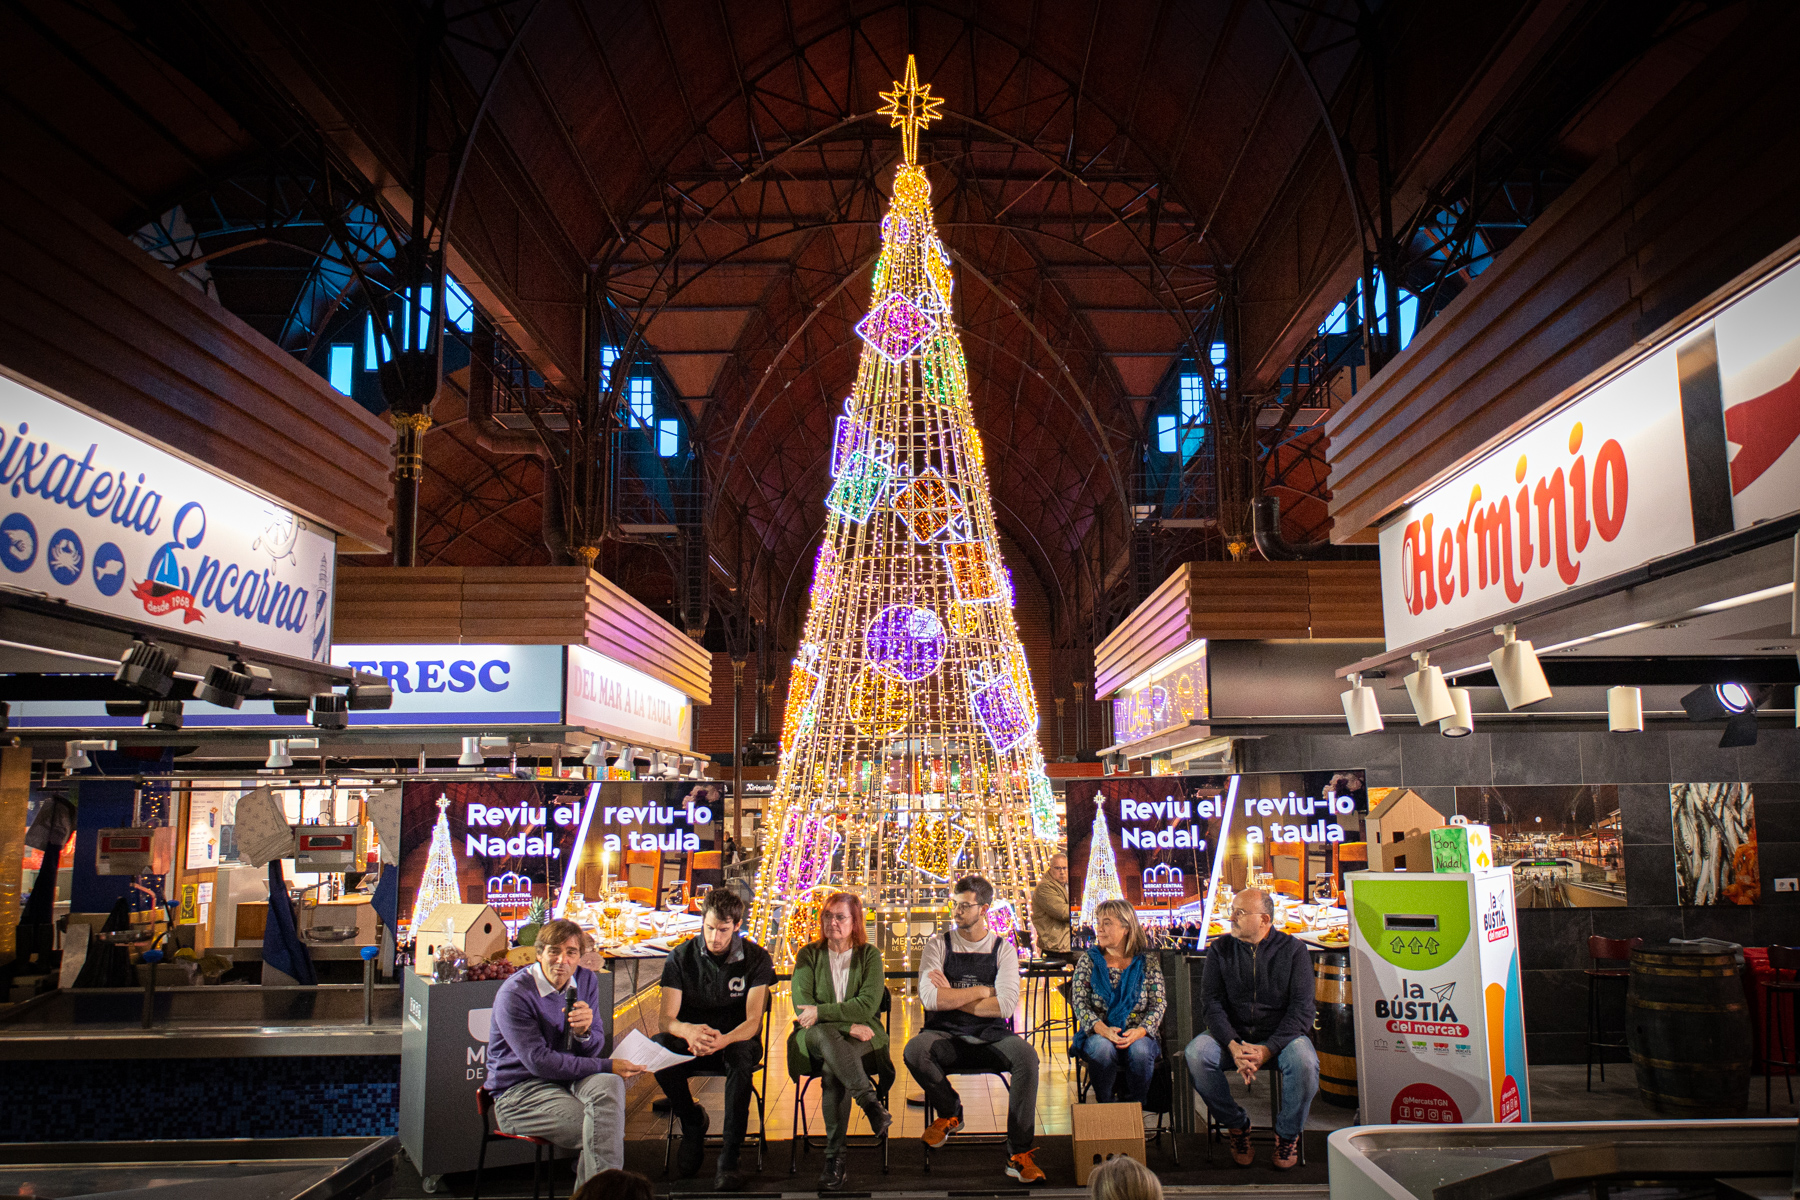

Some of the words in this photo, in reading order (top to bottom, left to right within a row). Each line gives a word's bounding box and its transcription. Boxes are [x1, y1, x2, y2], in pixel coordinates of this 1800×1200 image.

[0, 421, 163, 536] ixateria
[1403, 421, 1629, 617] Herminio
[147, 501, 309, 634] Encarna
[147, 600, 170, 612] desde
[171, 595, 190, 608] 1968
[573, 665, 597, 702] DEL
[599, 675, 622, 711] MAR
[624, 687, 632, 713] A
[633, 689, 645, 718] LA
[647, 695, 672, 727] TAULA
[466, 801, 547, 827] Reviu
[553, 801, 581, 826] el
[604, 801, 712, 825] reviu-lo
[1120, 795, 1191, 820] Reviu
[1197, 795, 1222, 818] el
[1244, 791, 1355, 817] reviu-lo
[602, 834, 621, 853] a
[628, 829, 700, 852] taula
[1121, 824, 1206, 851] Nadal,
[1245, 825, 1264, 845] a
[1269, 819, 1345, 844] taula
[1433, 833, 1458, 850] Bon
[466, 832, 560, 859] Nadal,
[1436, 853, 1463, 869] Nadal
[1489, 892, 1497, 909] la
[1483, 908, 1507, 931] BÚSTIA
[1402, 978, 1424, 999] la
[1375, 994, 1459, 1023] BÚSTIA
[1391, 1021, 1412, 1033] del
[1414, 1024, 1462, 1036] mercat
[466, 1067, 484, 1080] DE
[1402, 1096, 1449, 1107] @MercatsTGN
